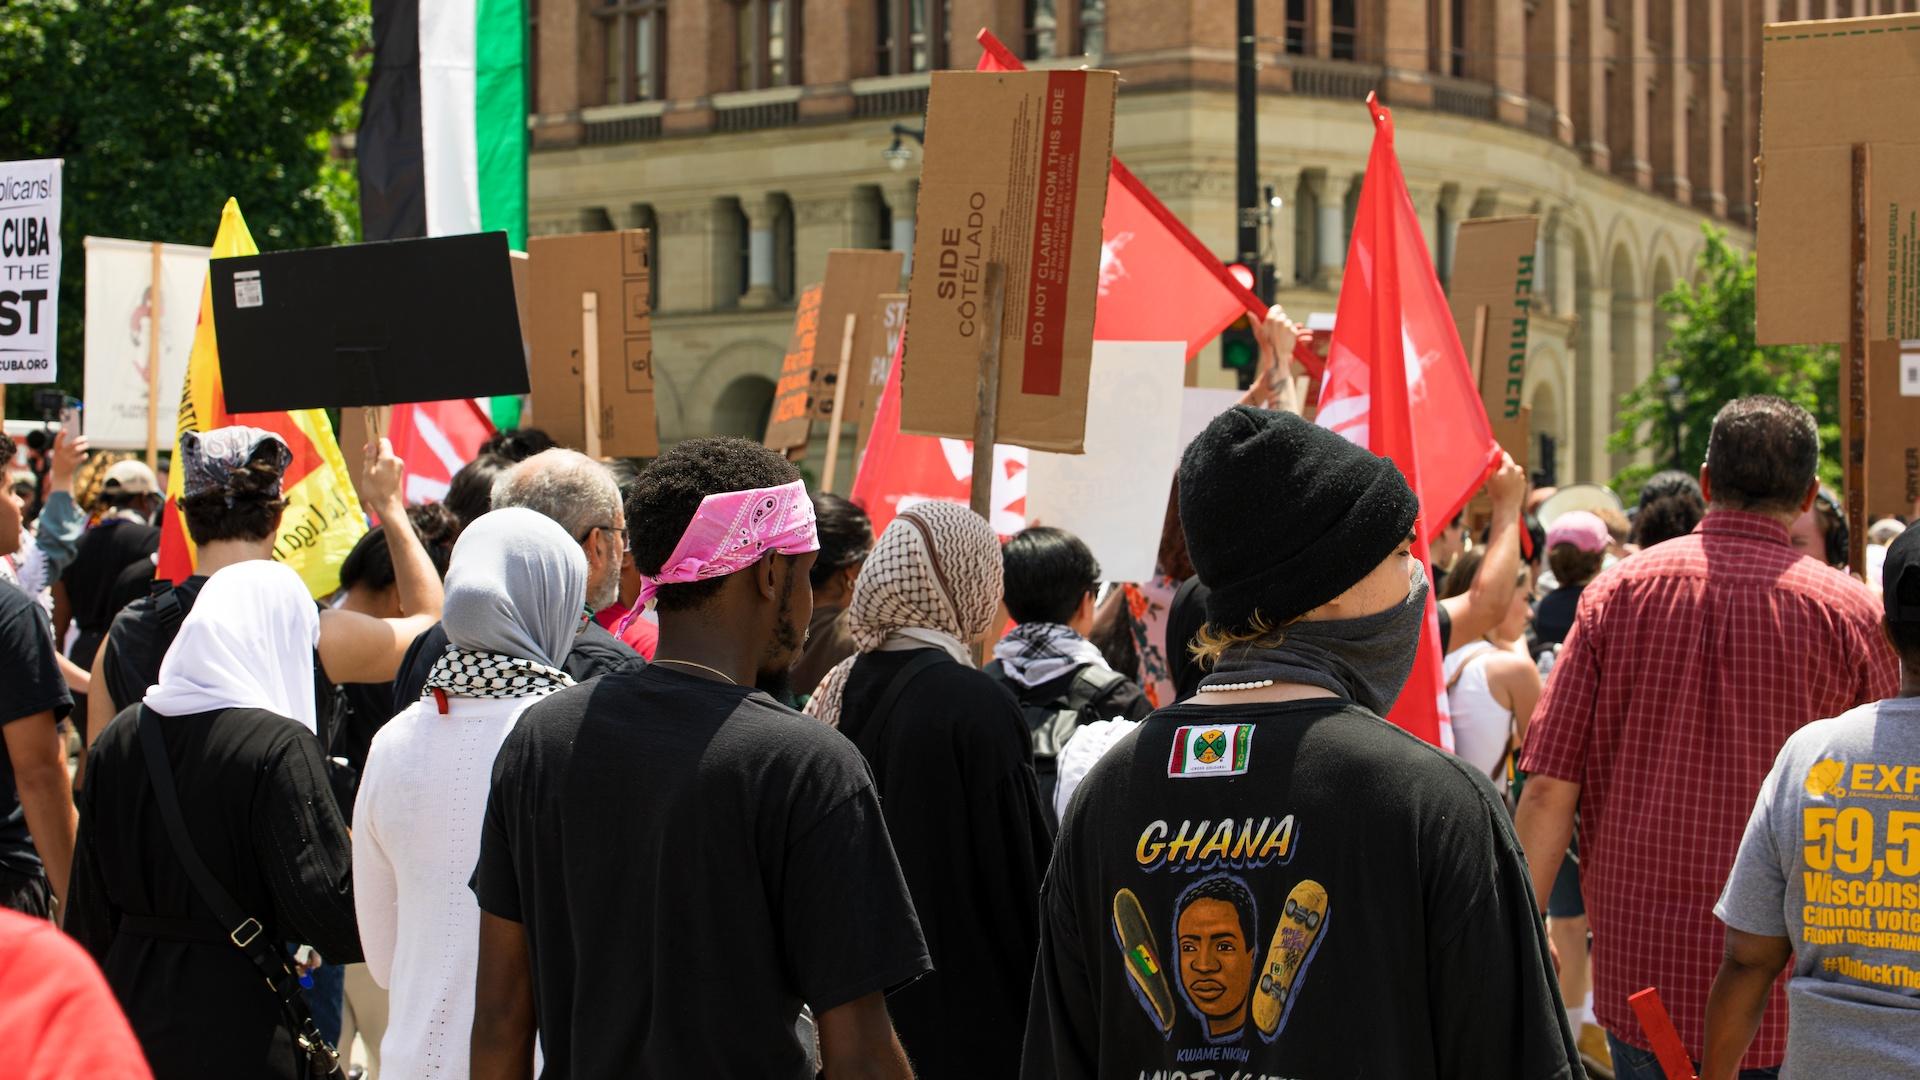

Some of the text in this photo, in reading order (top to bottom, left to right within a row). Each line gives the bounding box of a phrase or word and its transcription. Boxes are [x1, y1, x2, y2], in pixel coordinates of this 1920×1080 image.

[2, 217, 49, 258] CUBA
[1032, 88, 1065, 346] DO NOT CLAMP FROM THIS SIDE
[4, 263, 49, 281] THE
[937, 228, 961, 299] SIDE
[957, 192, 986, 337] CÔTÉ/LADO
[0, 289, 47, 336] ST
[1237, 726, 1249, 768] NATION
[1136, 815, 1299, 871] GHANA
[1803, 807, 1920, 880] 59,5
[1803, 872, 1920, 909] Wiscons
[1803, 905, 1920, 933] cannot vote
[1176, 1047, 1221, 1062] KWAME
